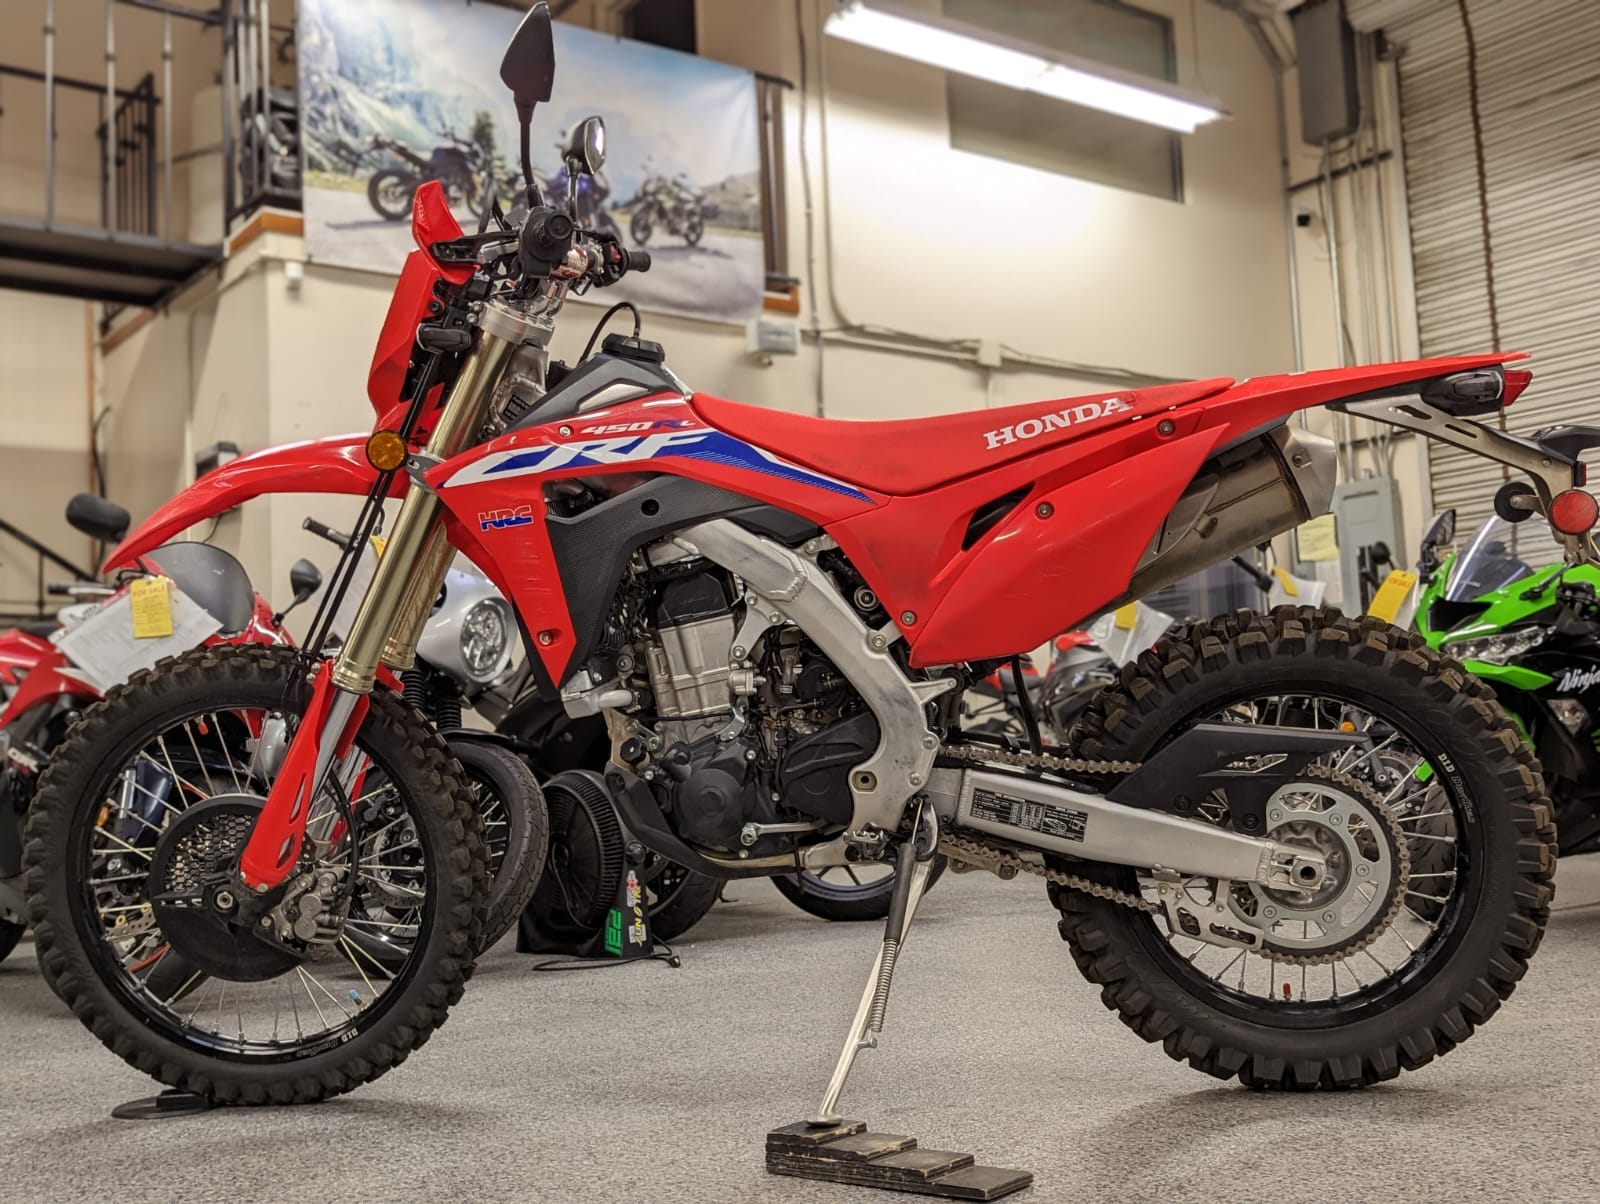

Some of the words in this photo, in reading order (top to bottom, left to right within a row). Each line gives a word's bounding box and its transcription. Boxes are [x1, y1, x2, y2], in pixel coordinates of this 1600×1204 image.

[983, 397, 1133, 450] HONDA
[443, 428, 712, 488] CRF
[478, 505, 534, 532] HRC
[132, 588, 148, 598] FOR
[149, 583, 166, 595] SALE
